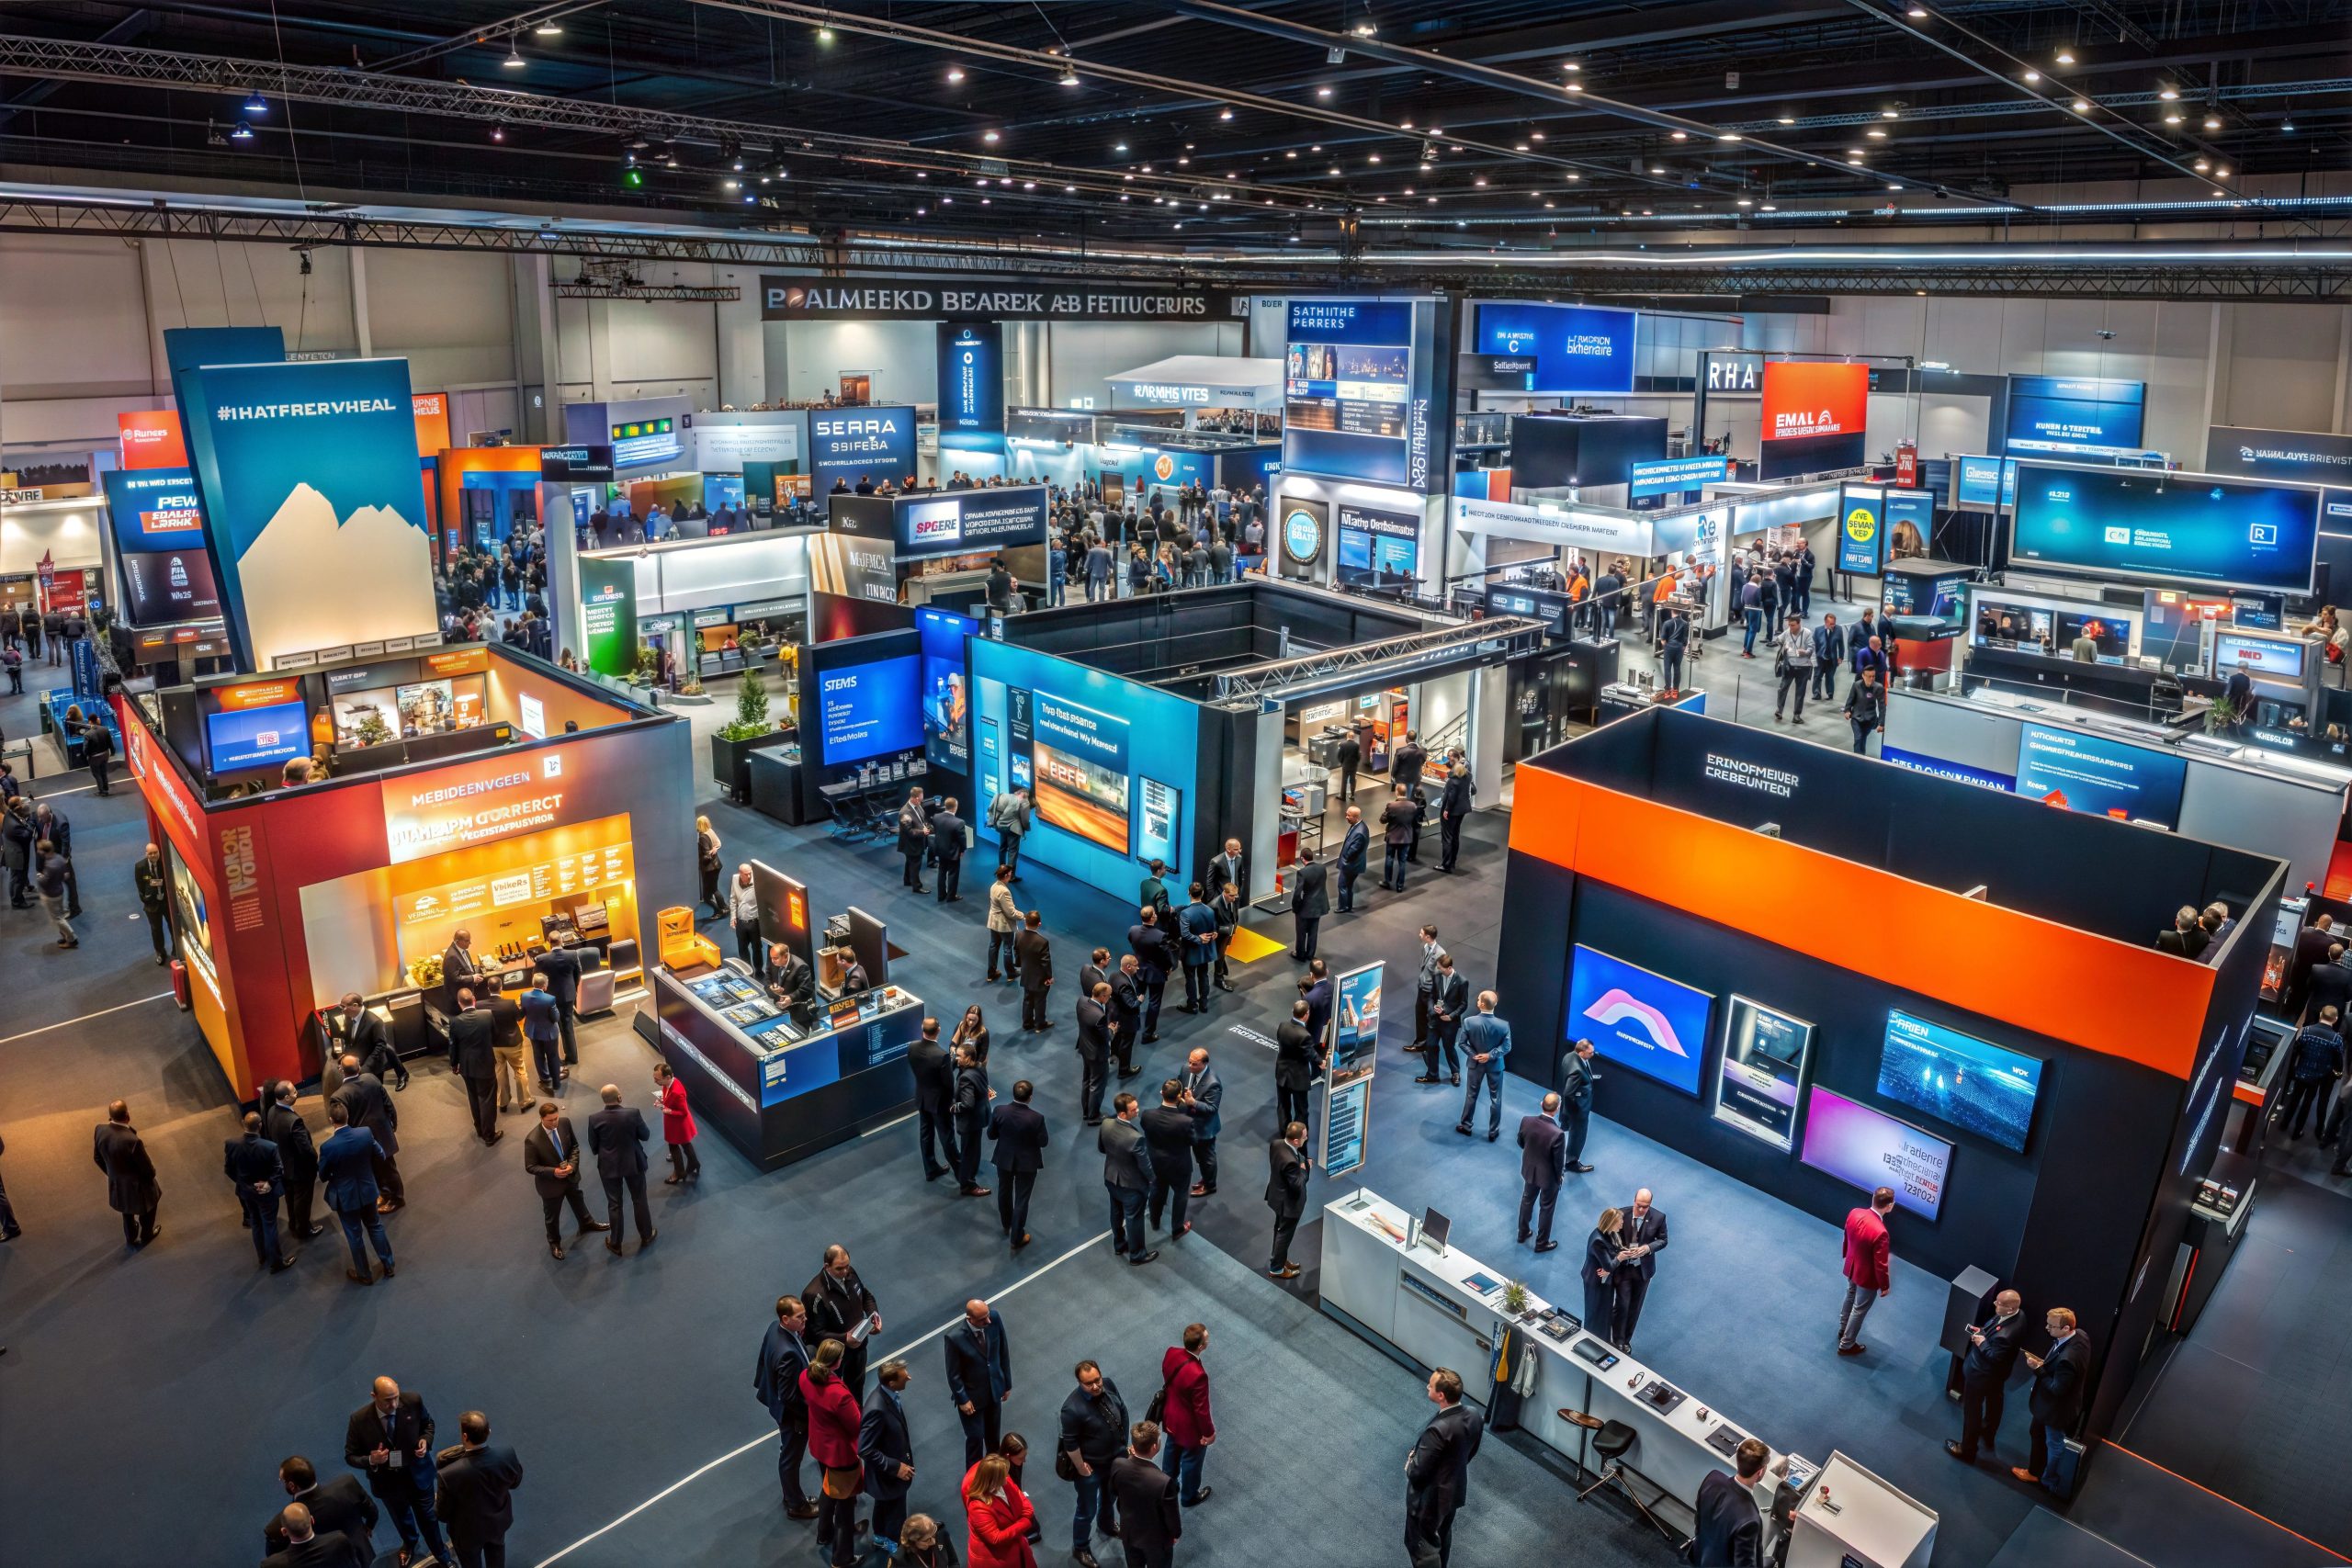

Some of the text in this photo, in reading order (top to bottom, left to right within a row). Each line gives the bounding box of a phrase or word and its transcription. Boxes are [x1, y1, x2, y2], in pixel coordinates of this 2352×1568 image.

[942, 291, 1043, 313] BEAREK
[1709, 361, 1755, 389] RHA
[2254, 527, 2265, 540] R
[825, 676, 857, 692] STEMS
